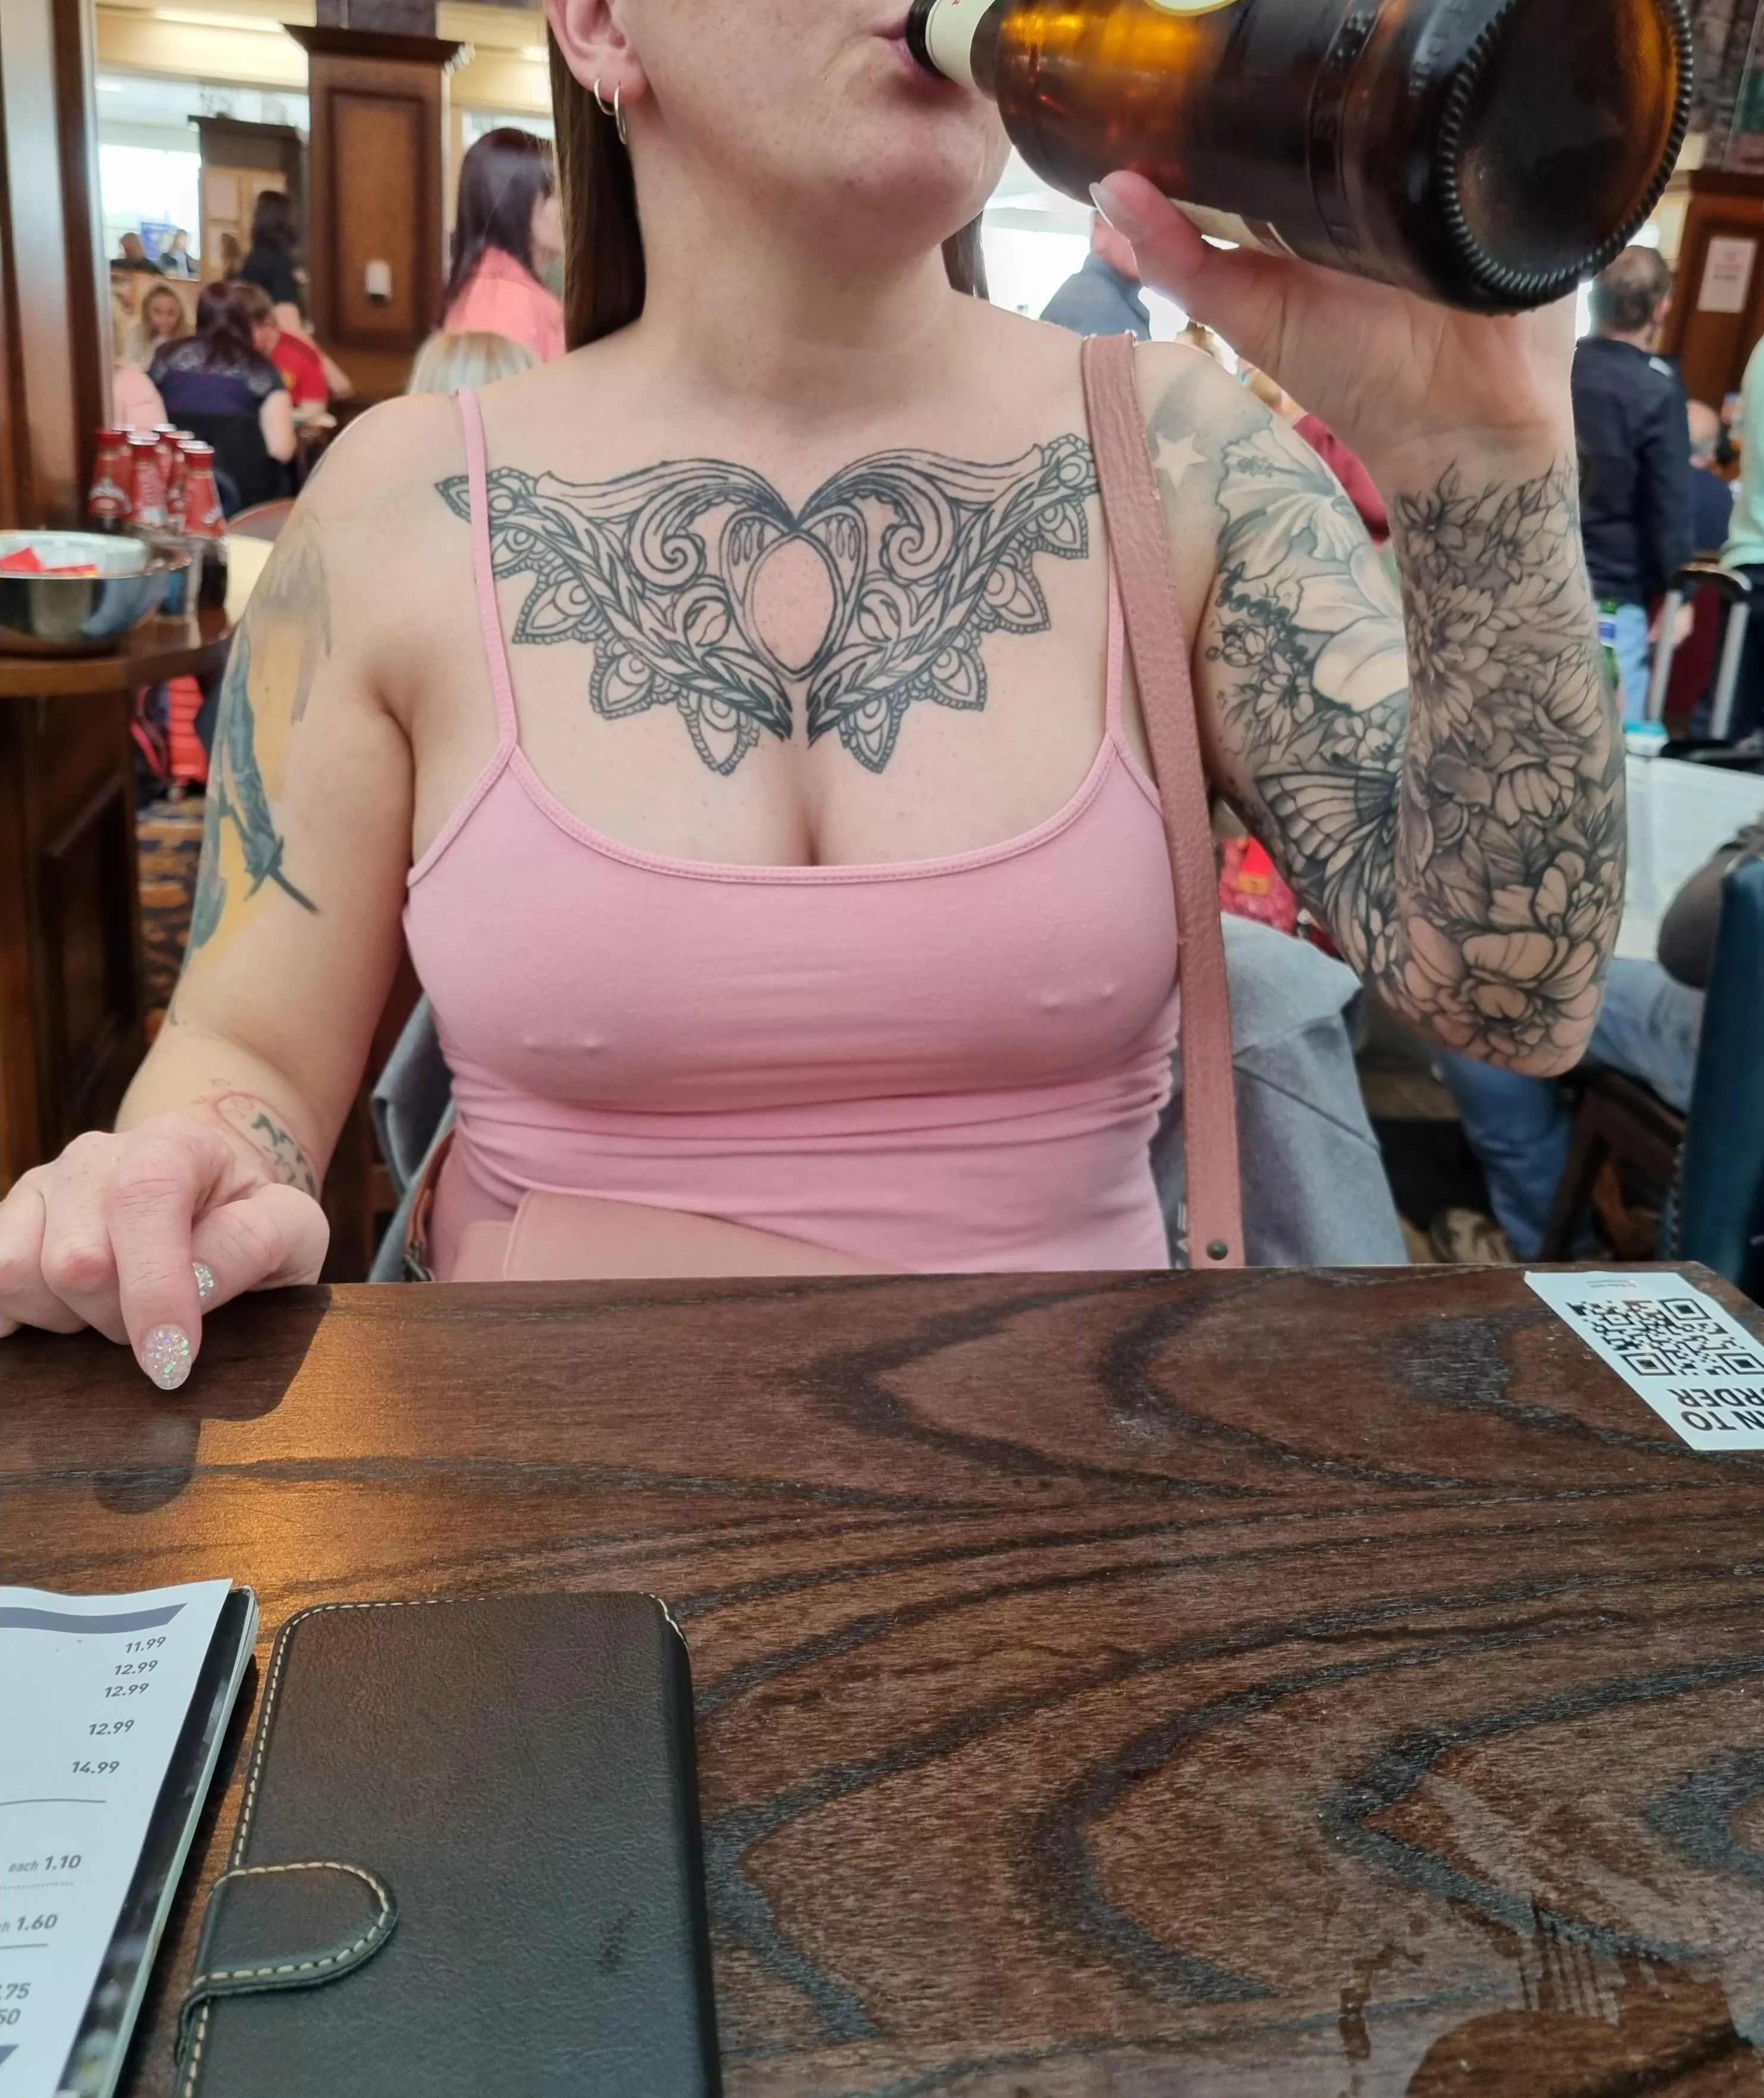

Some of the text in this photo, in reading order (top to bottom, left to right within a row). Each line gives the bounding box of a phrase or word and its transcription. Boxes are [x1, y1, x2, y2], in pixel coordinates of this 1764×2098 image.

[1665, 1388, 1764, 1408] RDER
[1680, 1410, 1737, 1432] TO
[125, 1636, 166, 1653] 11.99
[115, 1659, 158, 1675] 12.99
[105, 1683, 149, 1698] 12.99
[89, 1719, 134, 1735] 12.99
[72, 1760, 119, 1774] 14.99
[8, 1854, 82, 1873] each 1.10
[17, 1914, 58, 1932] 1.60
